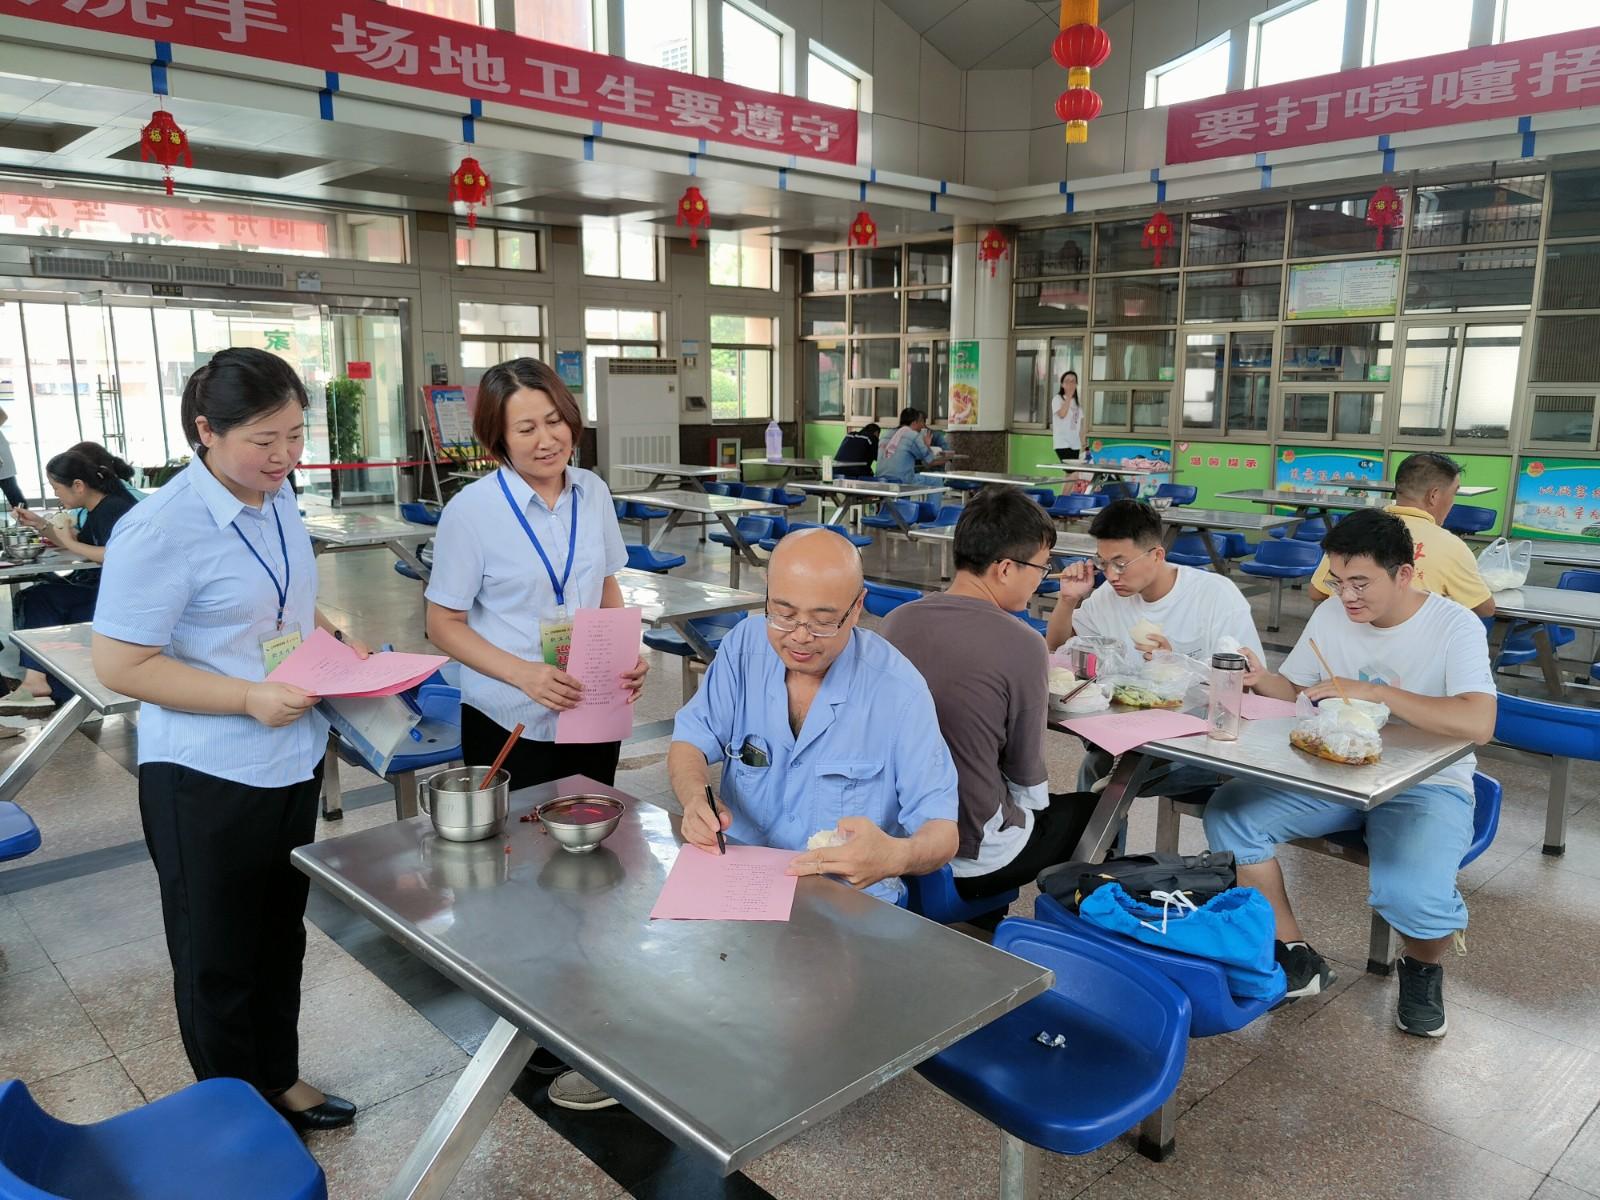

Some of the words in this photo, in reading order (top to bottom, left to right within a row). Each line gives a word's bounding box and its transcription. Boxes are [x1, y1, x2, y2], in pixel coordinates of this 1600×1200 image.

[331, 13, 840, 152] 场地卫生要遵守
[1192, 45, 1600, 148] 要打喷嚏捂
